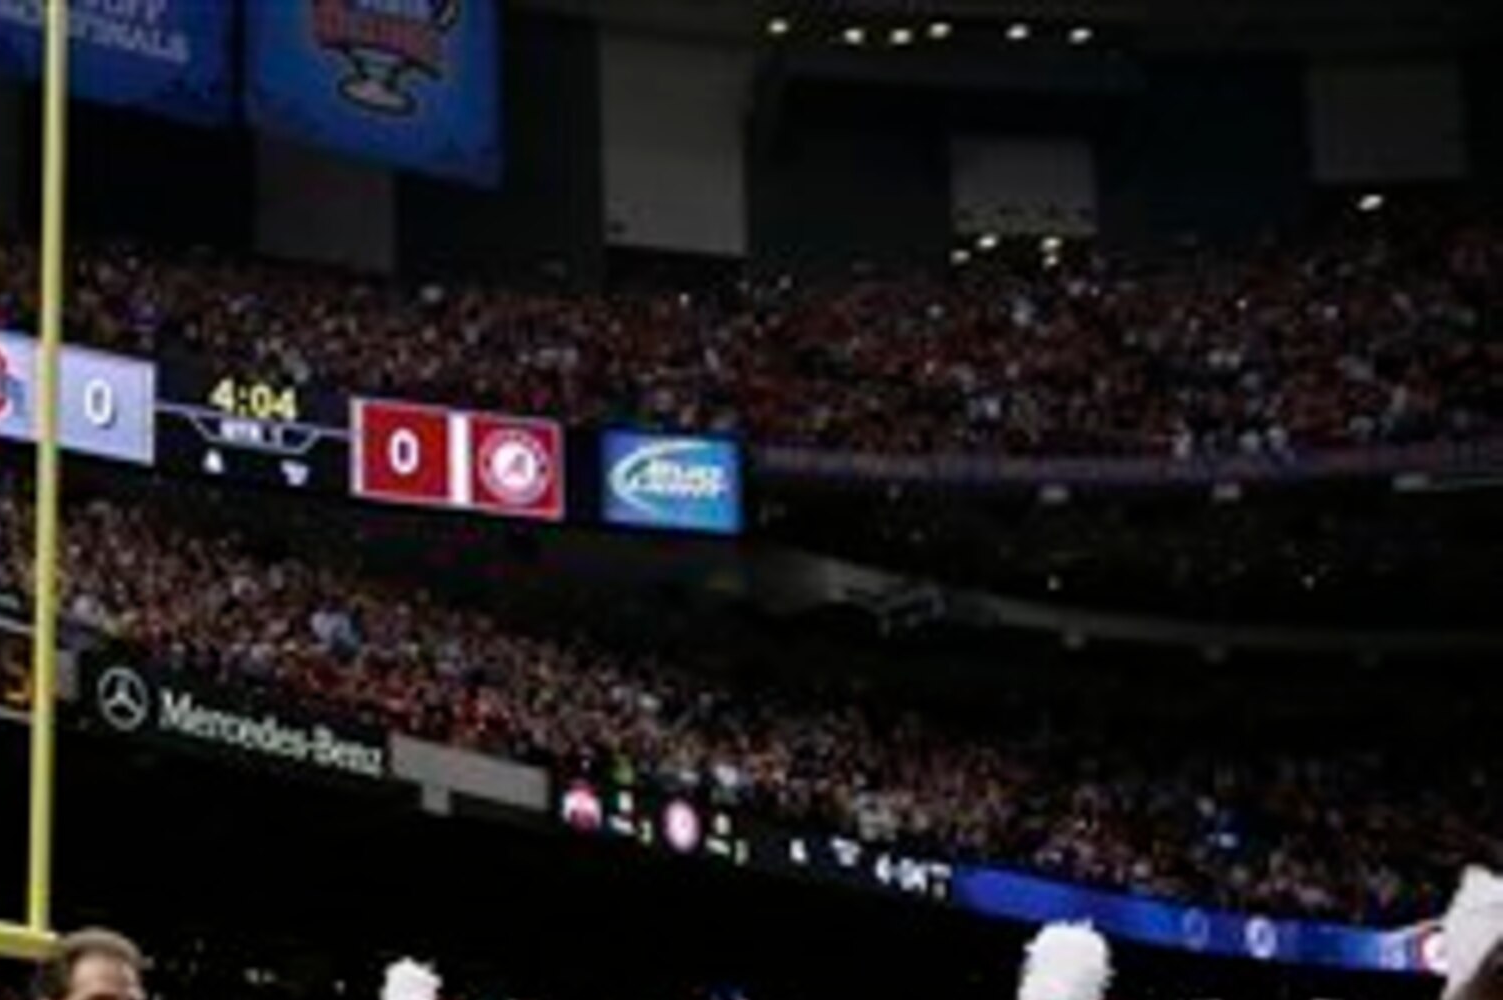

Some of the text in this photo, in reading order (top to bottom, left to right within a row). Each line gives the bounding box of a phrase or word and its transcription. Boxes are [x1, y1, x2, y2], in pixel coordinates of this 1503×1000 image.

[85, 379, 114, 425] 0
[210, 377, 297, 421] 4:04
[389, 428, 420, 476] 0
[159, 688, 383, 777] Mercedes-Benz
